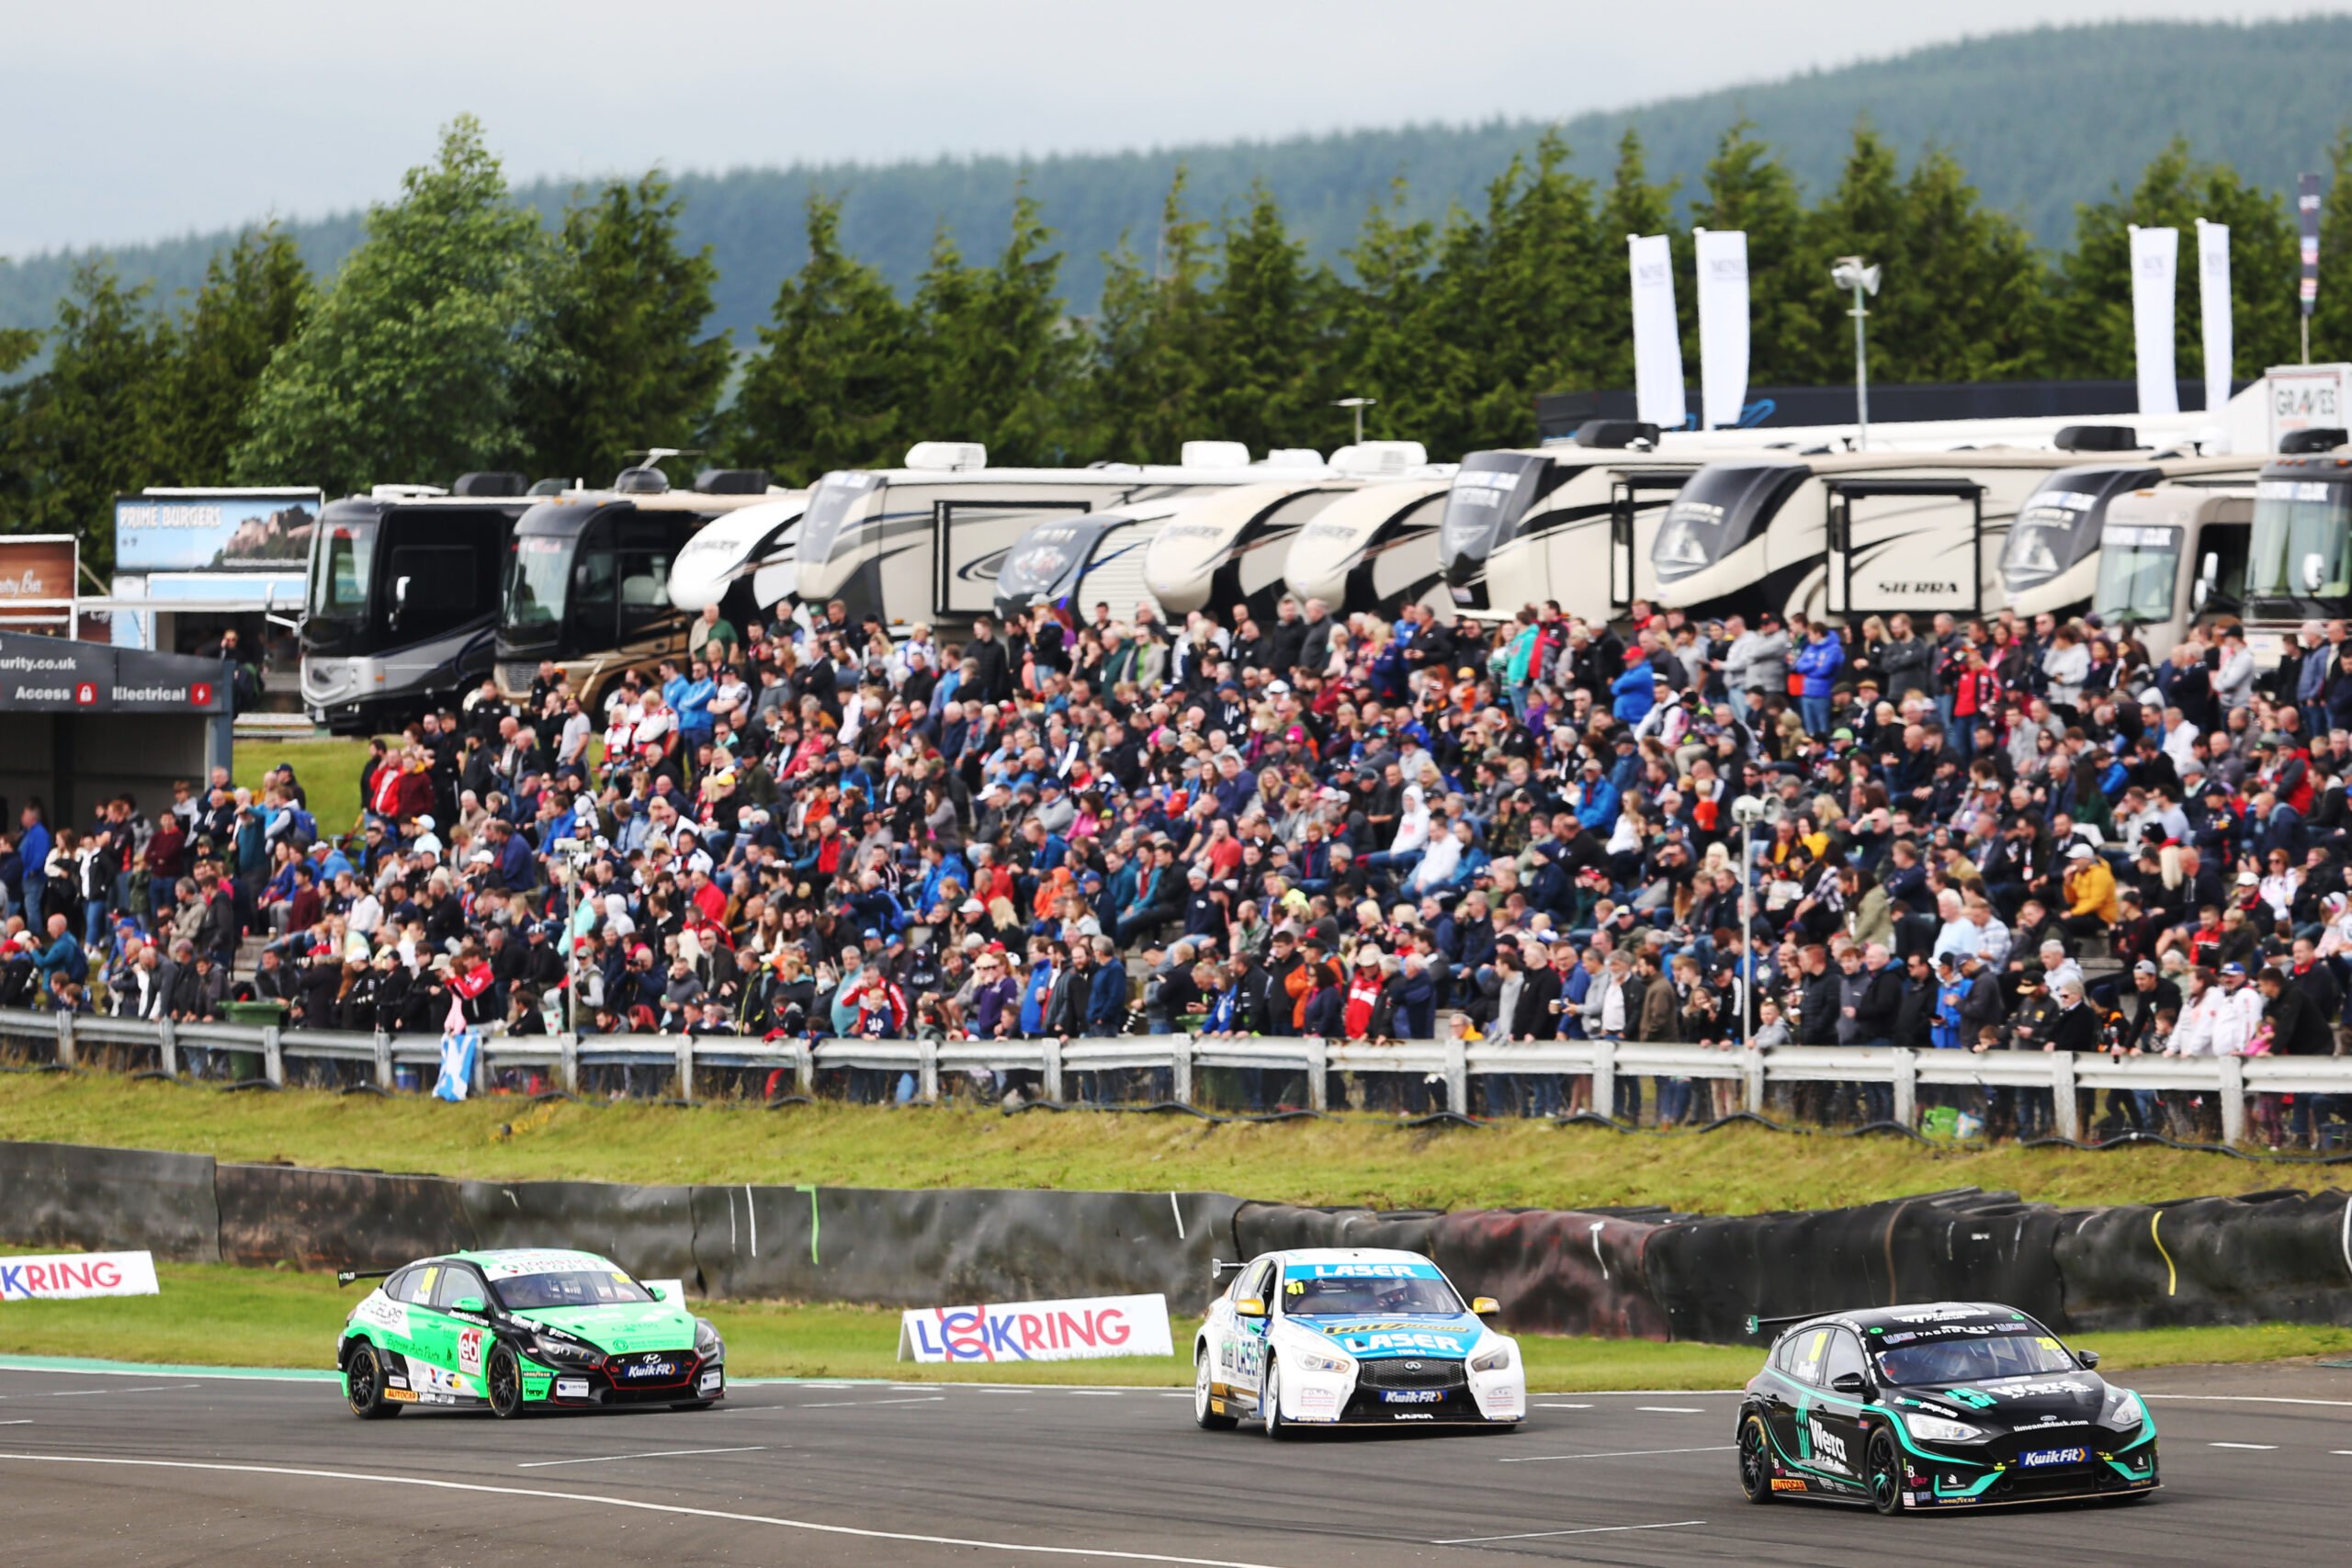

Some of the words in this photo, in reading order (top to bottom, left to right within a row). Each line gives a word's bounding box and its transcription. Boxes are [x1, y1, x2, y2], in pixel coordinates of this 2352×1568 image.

[2276, 389, 2335, 415] GRAVES
[119, 506, 158, 529] PRIME
[162, 506, 221, 528] BURGERS
[1879, 581, 1958, 593] SIERRA
[0, 657, 77, 671] urity.co.uk
[16, 686, 71, 700] Access
[112, 686, 187, 701] Electrical
[1315, 1265, 1419, 1278] LASER
[1286, 1281, 1305, 1295] 41
[458, 1327, 482, 1362] febi
[1344, 1333, 1464, 1353] LASER
[389, 1389, 416, 1402] AUTOCAR
[2013, 1420, 2089, 1432] limeandblack.com
[1808, 1416, 1848, 1461] Wera
[1772, 1480, 1804, 1492] AUTOCAR
